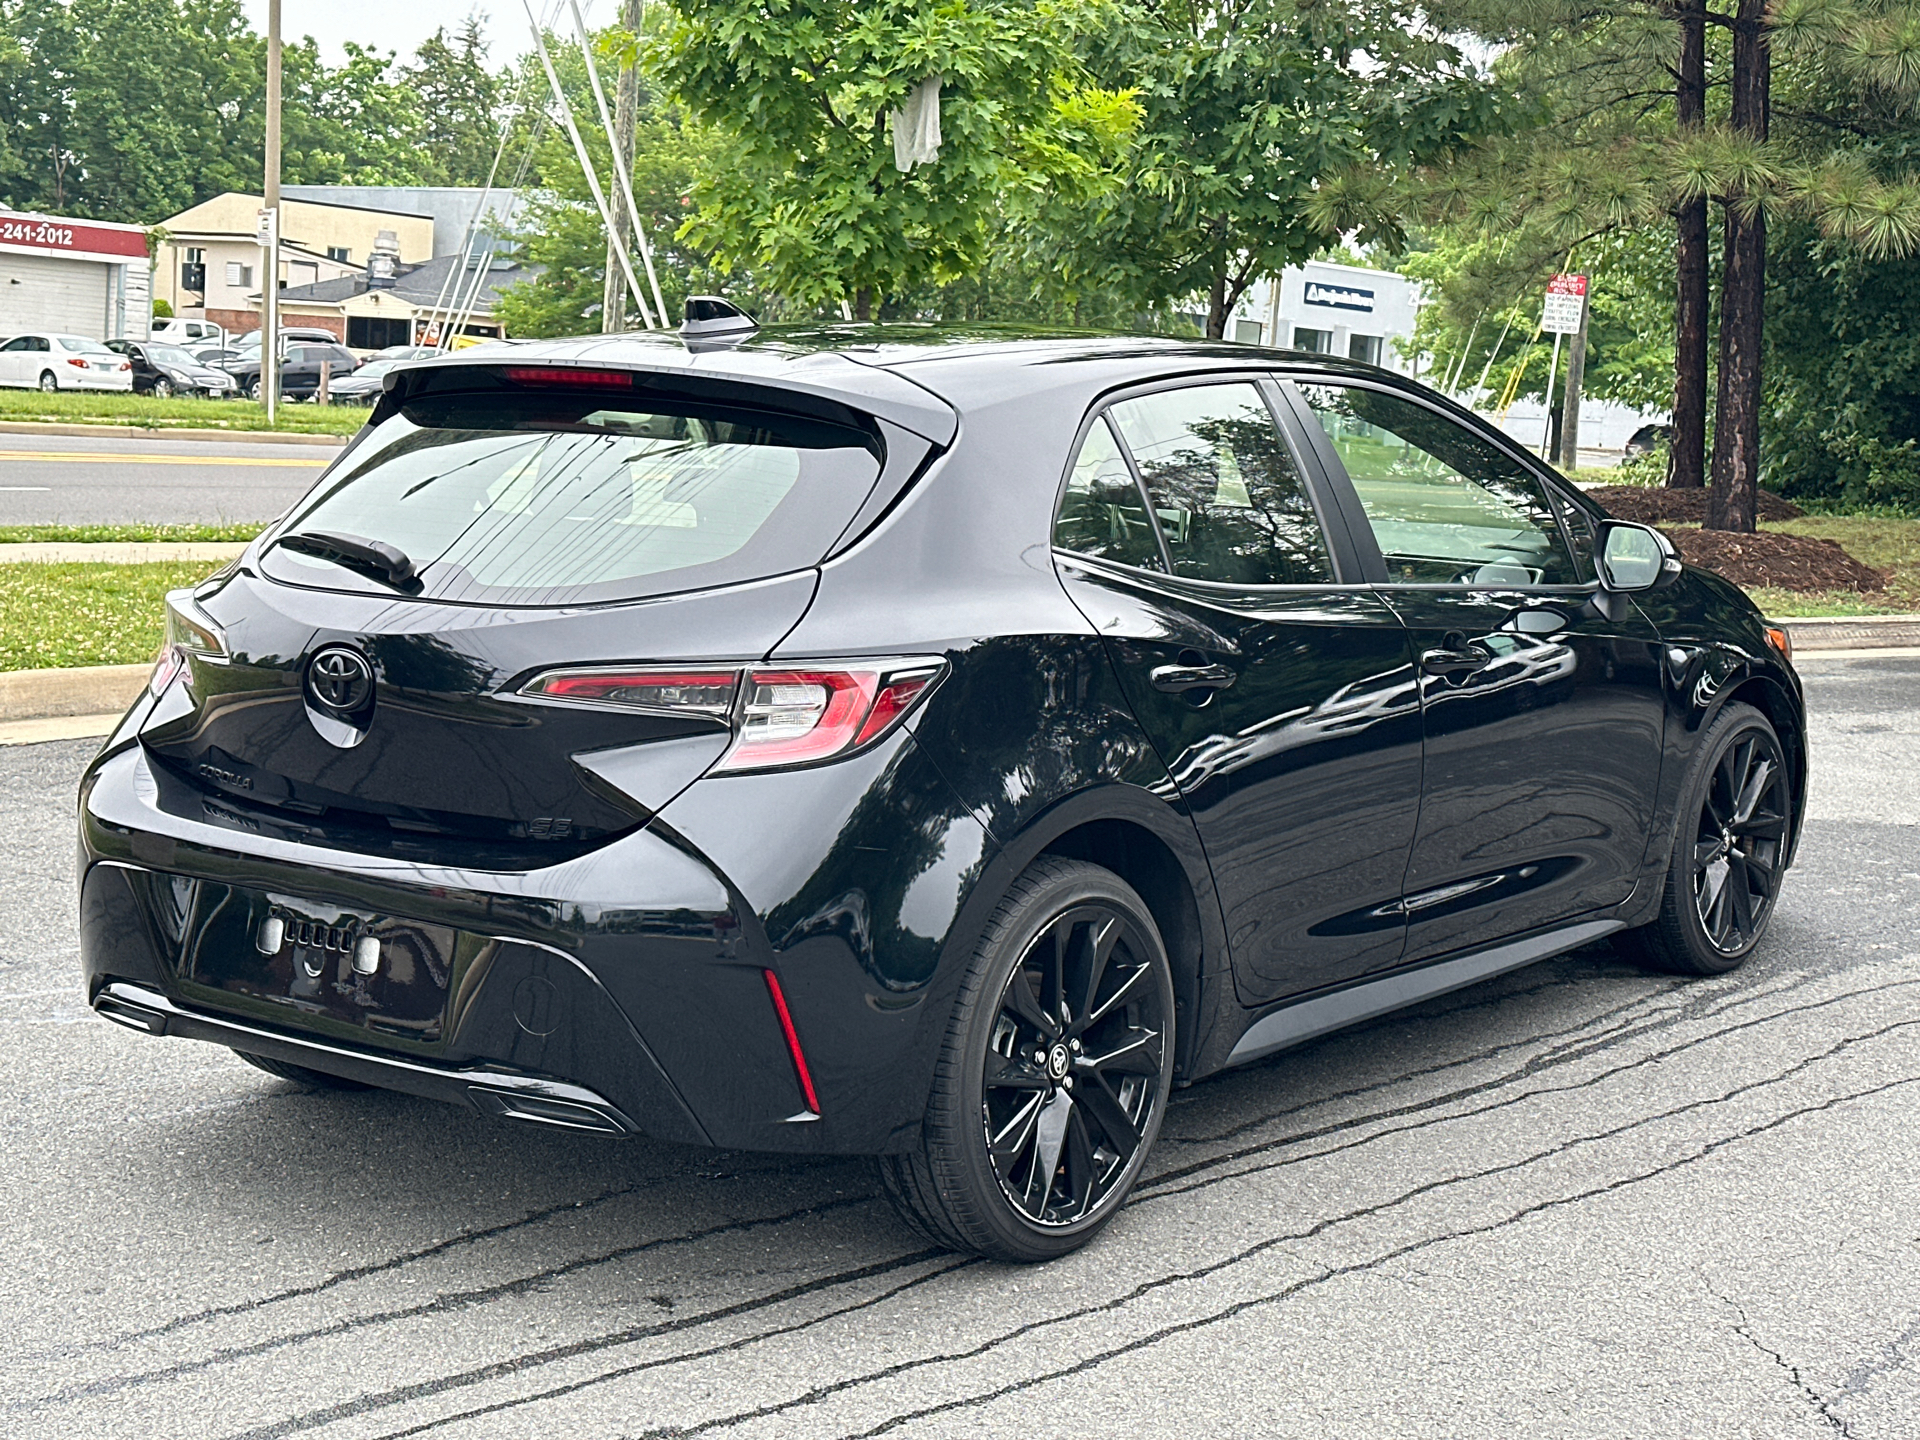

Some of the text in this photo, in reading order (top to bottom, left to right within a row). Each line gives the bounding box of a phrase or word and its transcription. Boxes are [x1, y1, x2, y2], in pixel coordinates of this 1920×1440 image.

[0, 223, 73, 245] -241-2012
[198, 764, 254, 791] COROLLA
[529, 817, 572, 837] SE
